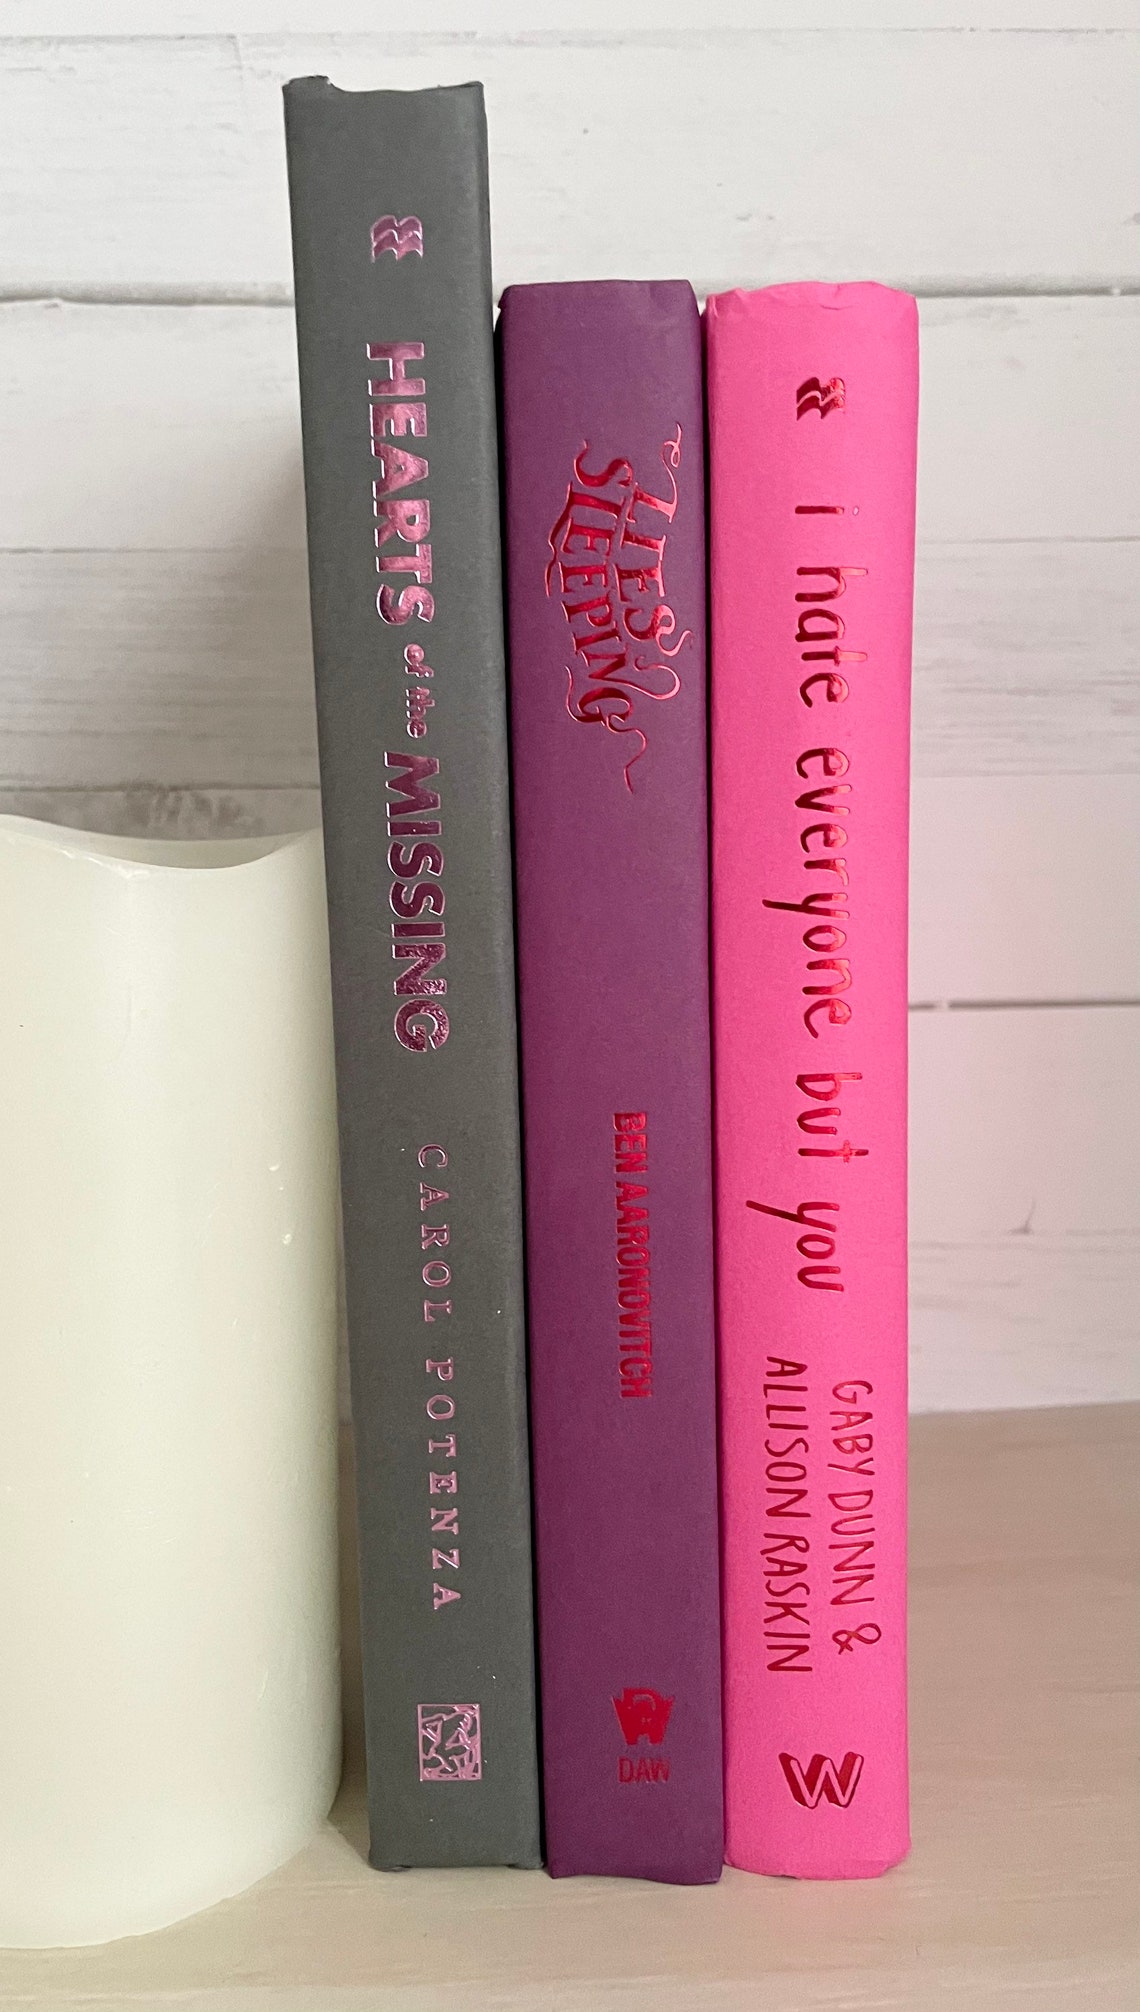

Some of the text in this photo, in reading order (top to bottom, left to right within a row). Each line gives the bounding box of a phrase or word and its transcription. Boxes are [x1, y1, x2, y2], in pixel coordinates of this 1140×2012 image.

[366, 341, 451, 1053] HEARTS of the MISSING
[545, 439, 682, 794] SLEEPING
[614, 422, 693, 657] LIES
[745, 504, 869, 1292] i hate everyone but you
[417, 1143, 461, 1610] CAROL POTENZA
[613, 1111, 654, 1398] BEN AARONOVITCH
[760, 1355, 813, 1673] ALLISON RASKIN
[827, 1380, 882, 1655] GABY DUNN &
[616, 1756, 672, 1785] DAW
